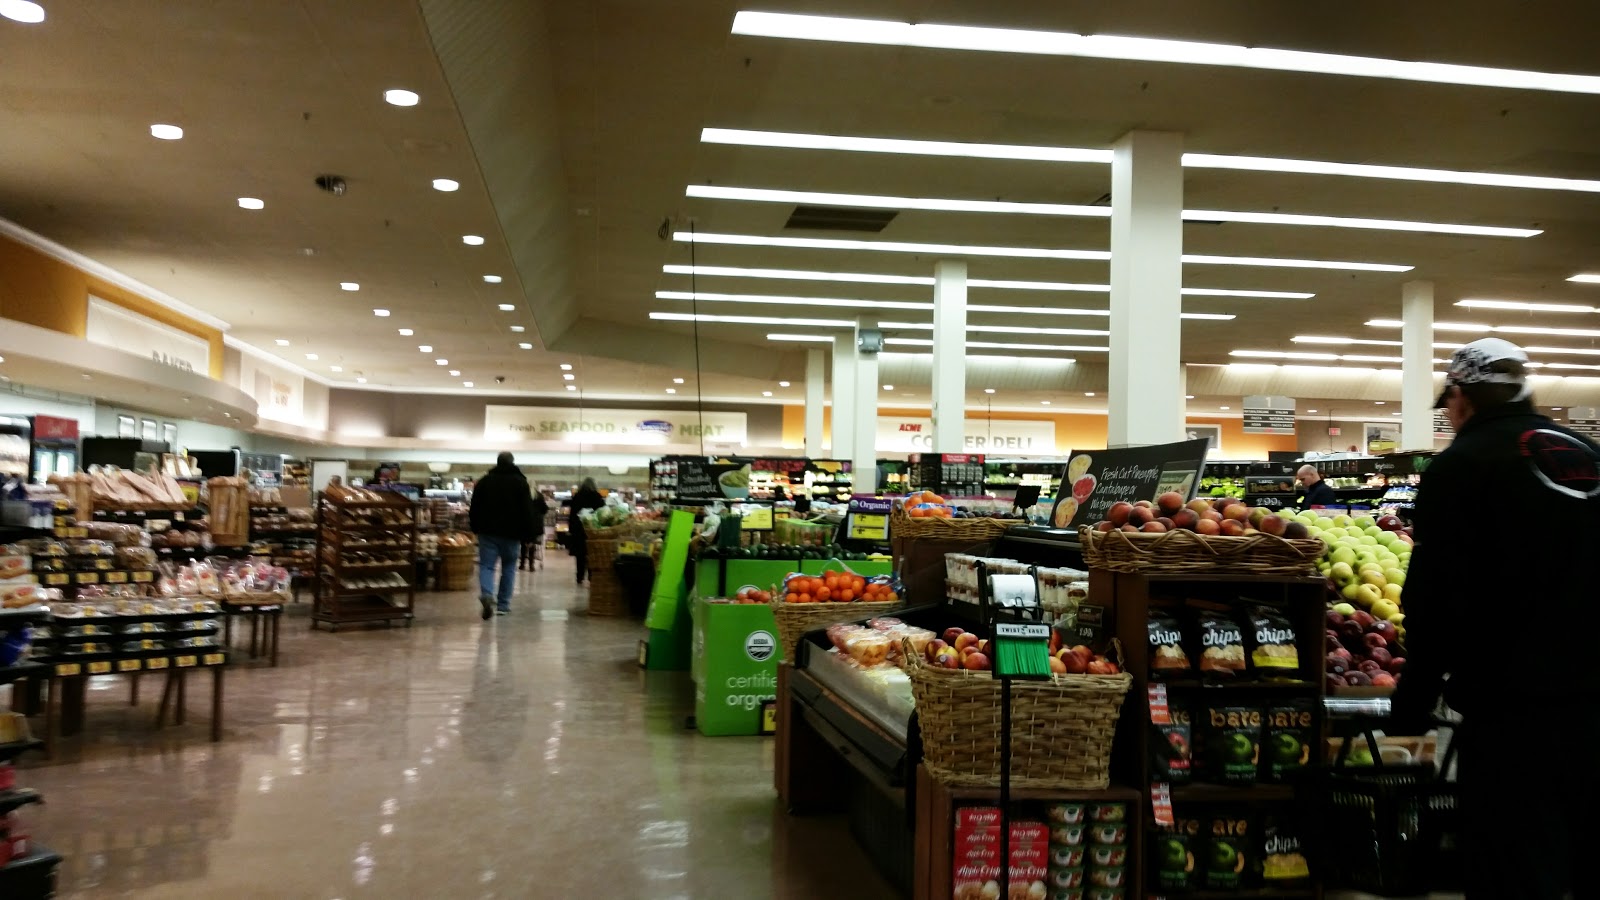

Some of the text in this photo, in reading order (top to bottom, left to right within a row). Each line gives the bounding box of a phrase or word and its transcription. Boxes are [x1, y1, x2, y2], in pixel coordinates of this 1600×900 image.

[509, 423, 536, 433] Fresh
[539, 420, 615, 433] SEAFOOD
[679, 424, 724, 436] MEAT
[898, 423, 922, 432] ACME
[911, 434, 1032, 449] COER DELI
[1101, 466, 1118, 480] Fresh
[1118, 466, 1132, 479] Cut
[859, 501, 890, 510] Organic
[1149, 630, 1181, 645] chips
[1202, 630, 1242, 646] chips
[1256, 627, 1295, 644] chips
[726, 670, 777, 688] certifie
[1209, 708, 1262, 728] bare
[1268, 710, 1312, 727] are
[1265, 835, 1299, 853] chips
[957, 864, 1001, 877] Apple Crisp
[1026, 865, 1047, 877] Crisp
